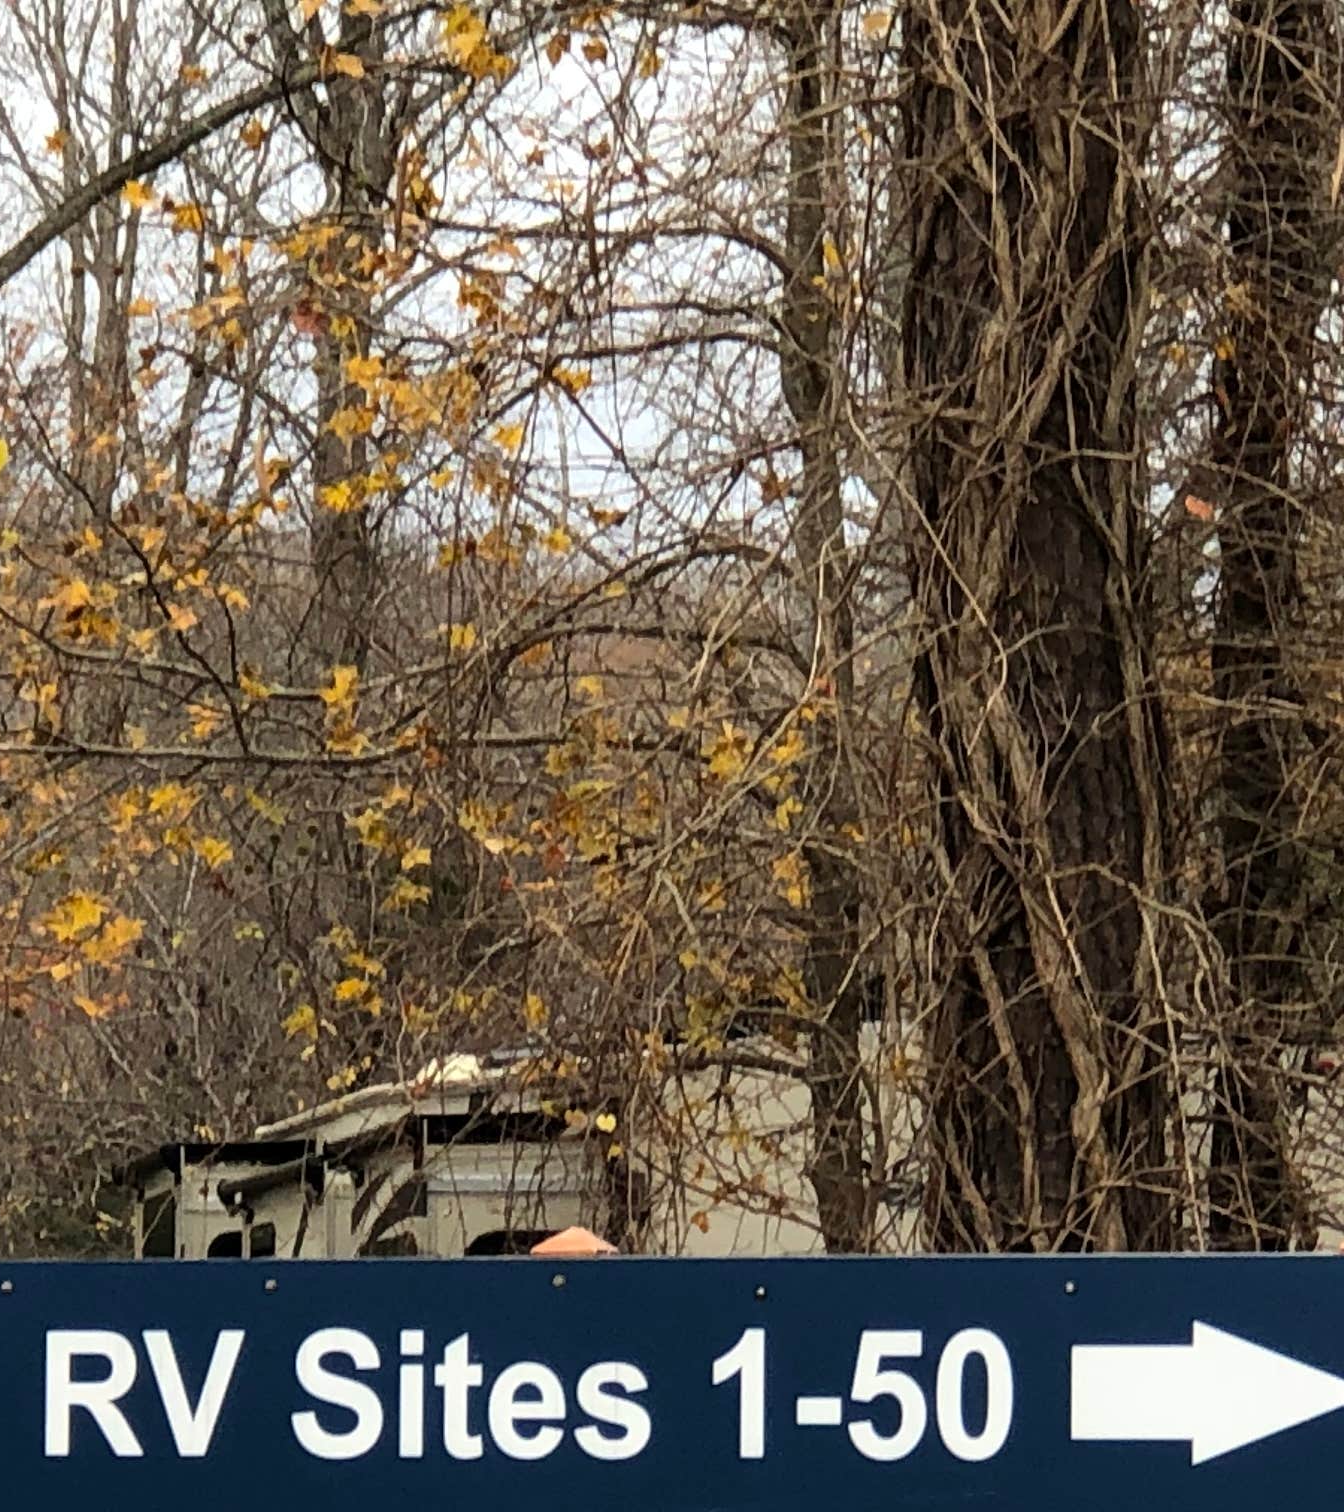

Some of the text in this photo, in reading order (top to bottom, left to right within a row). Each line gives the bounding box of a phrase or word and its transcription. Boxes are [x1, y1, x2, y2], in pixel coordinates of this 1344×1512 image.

[45, 1327, 1014, 1462] RV Sites 1-50
